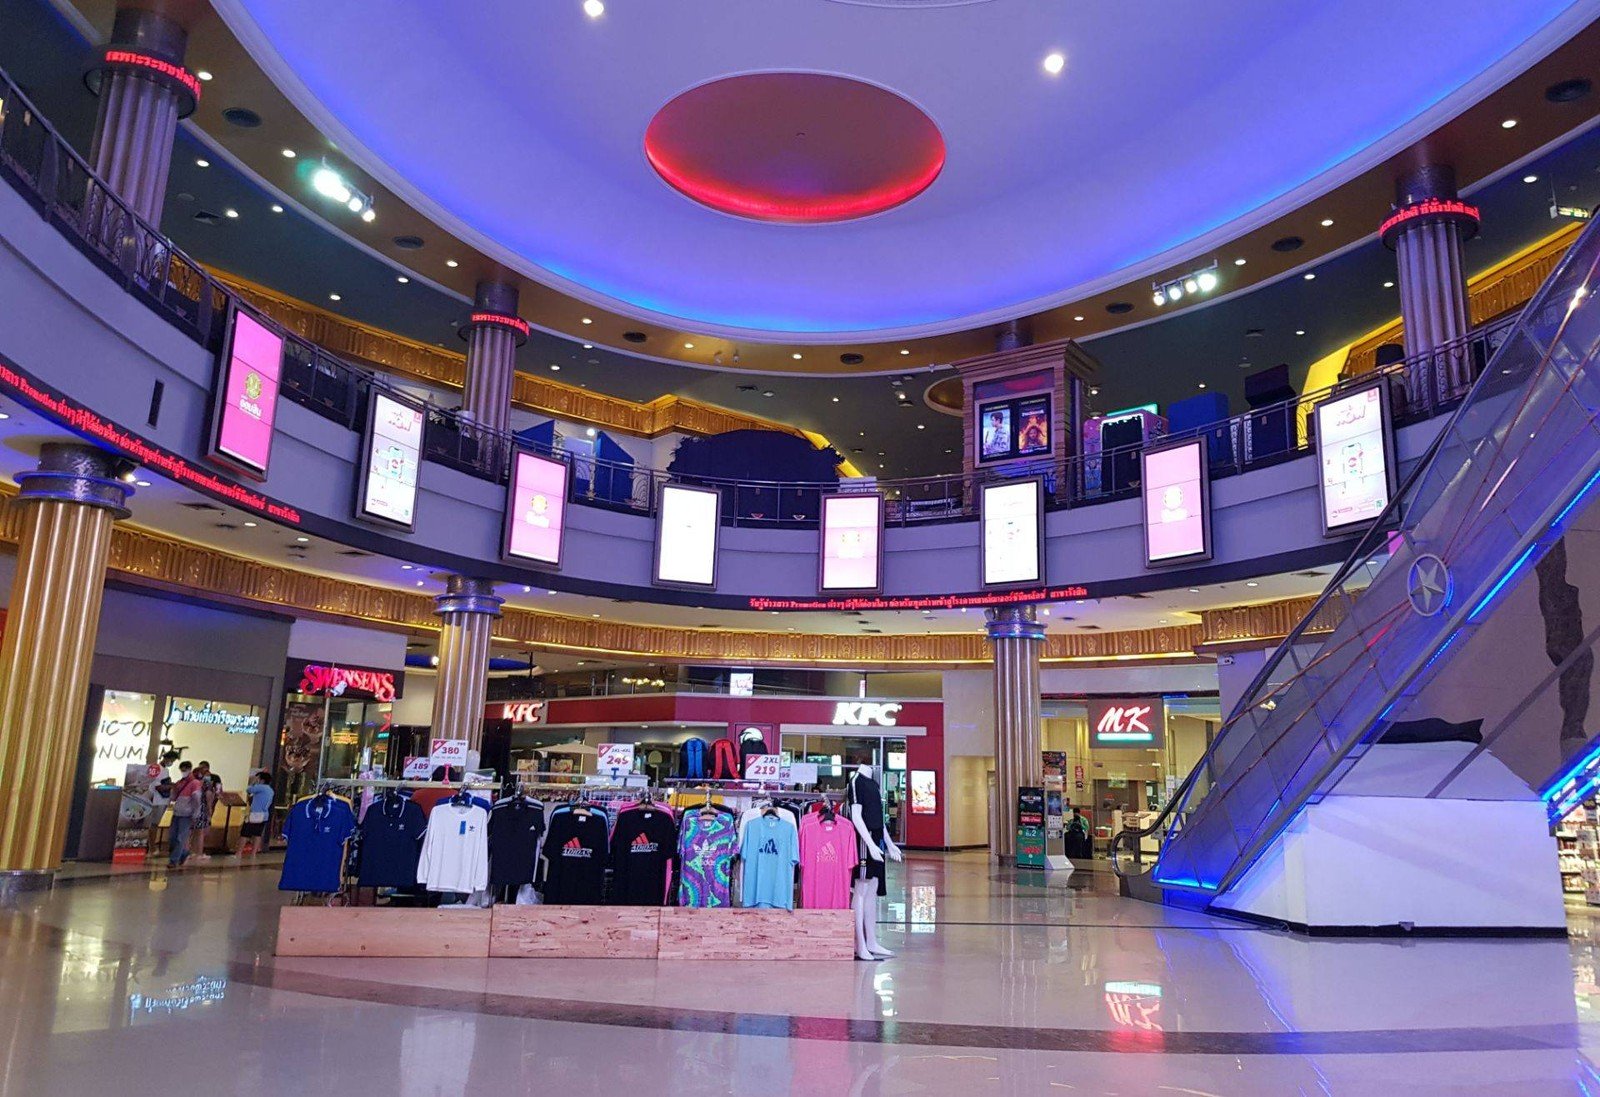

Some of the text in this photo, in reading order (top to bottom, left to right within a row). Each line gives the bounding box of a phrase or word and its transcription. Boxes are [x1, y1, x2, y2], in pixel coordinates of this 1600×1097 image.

[503, 702, 543, 722] KFC
[832, 702, 902, 726] KFC
[1097, 706, 1151, 732] MK
[442, 747, 460, 755] 380
[607, 755, 629, 765] 245
[764, 756, 779, 764] 2XL
[754, 765, 776, 775] 219
